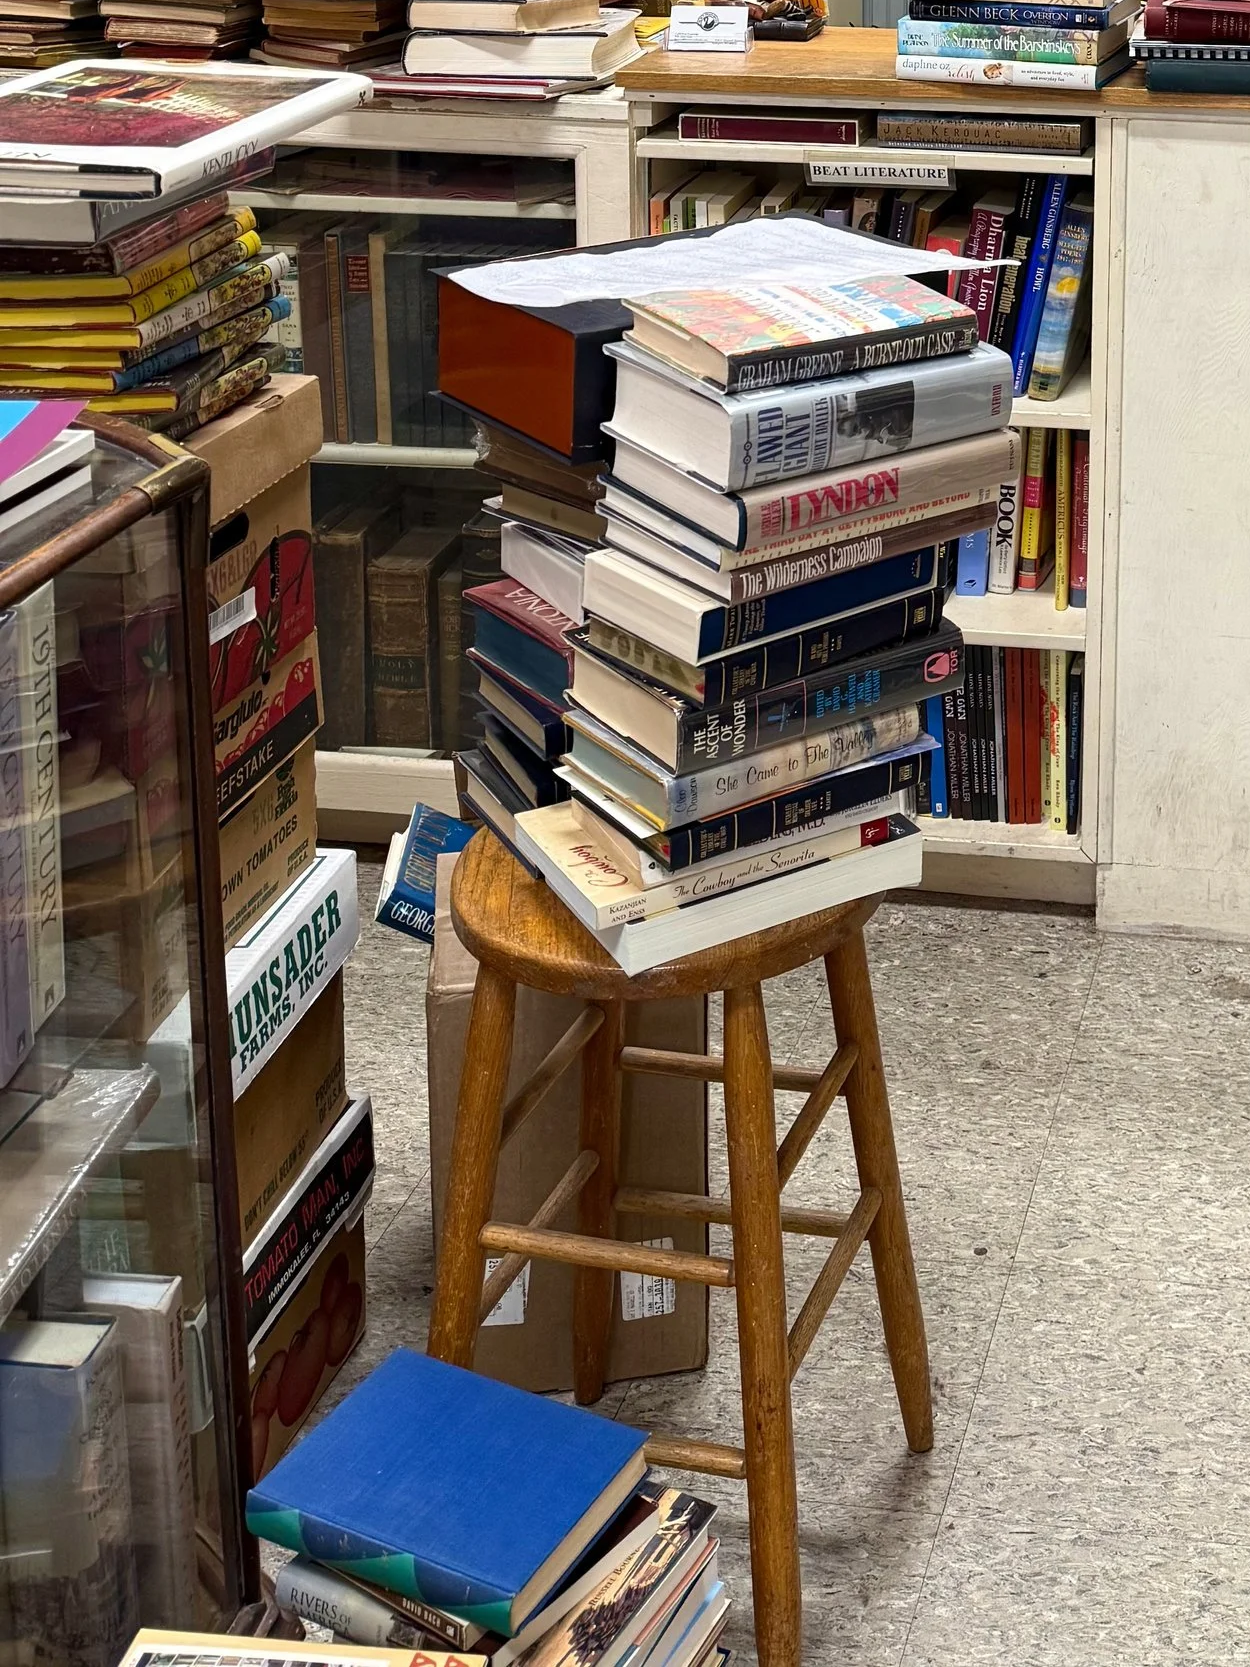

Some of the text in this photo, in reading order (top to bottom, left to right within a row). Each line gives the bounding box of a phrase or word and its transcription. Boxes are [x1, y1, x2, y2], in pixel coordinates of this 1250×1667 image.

[930, 4, 1019, 21] GLENN BECK
[1023, 11, 1068, 21] OVERTON
[902, 59, 938, 71] daphne
[931, 33, 1081, 55] The Summer of the Barshinskeys
[883, 123, 1001, 140] JACK KEROUAC
[202, 139, 258, 176] KENTUCKY
[812, 165, 947, 179] BEAT LITERATURE
[1014, 235, 1031, 260] beat
[1032, 181, 1061, 292] ALLEN GINSBERG HOWL
[977, 278, 996, 311] Lion
[737, 331, 955, 392] GRAHAM GREENE BURNT-OUT CASE
[754, 406, 784, 484] FLAWED
[782, 413, 811, 474] GIANT
[787, 467, 900, 532] LYNDON
[908, 492, 971, 517] AND BEYOND
[996, 483, 1018, 548] BOOK
[739, 535, 883, 598] The Wilderness Campaign
[832, 686, 841, 712] DAVID
[693, 730, 706, 755] THE
[706, 713, 720, 760] ASCENT
[721, 725, 733, 742] OF
[732, 699, 746, 757] WONDER
[947, 729, 957, 772] JONATHAN
[716, 729, 874, 796] She Came to The Valley
[958, 732, 971, 802] JONATHAN MILLER
[35, 729, 57, 930] CENTURY
[246, 814, 298, 873] TOMATOES
[673, 849, 815, 899] The Cowboy the Senorita
[239, 951, 329, 1074] FARMS, INC.
[244, 1137, 365, 1308] TOMATO MAN, INC
[268, 1190, 350, 1304] IMMOKALEE, FL 34143
[290, 1587, 352, 1625] RIVERS OF
[588, 1572, 619, 1608] RUSSELL
